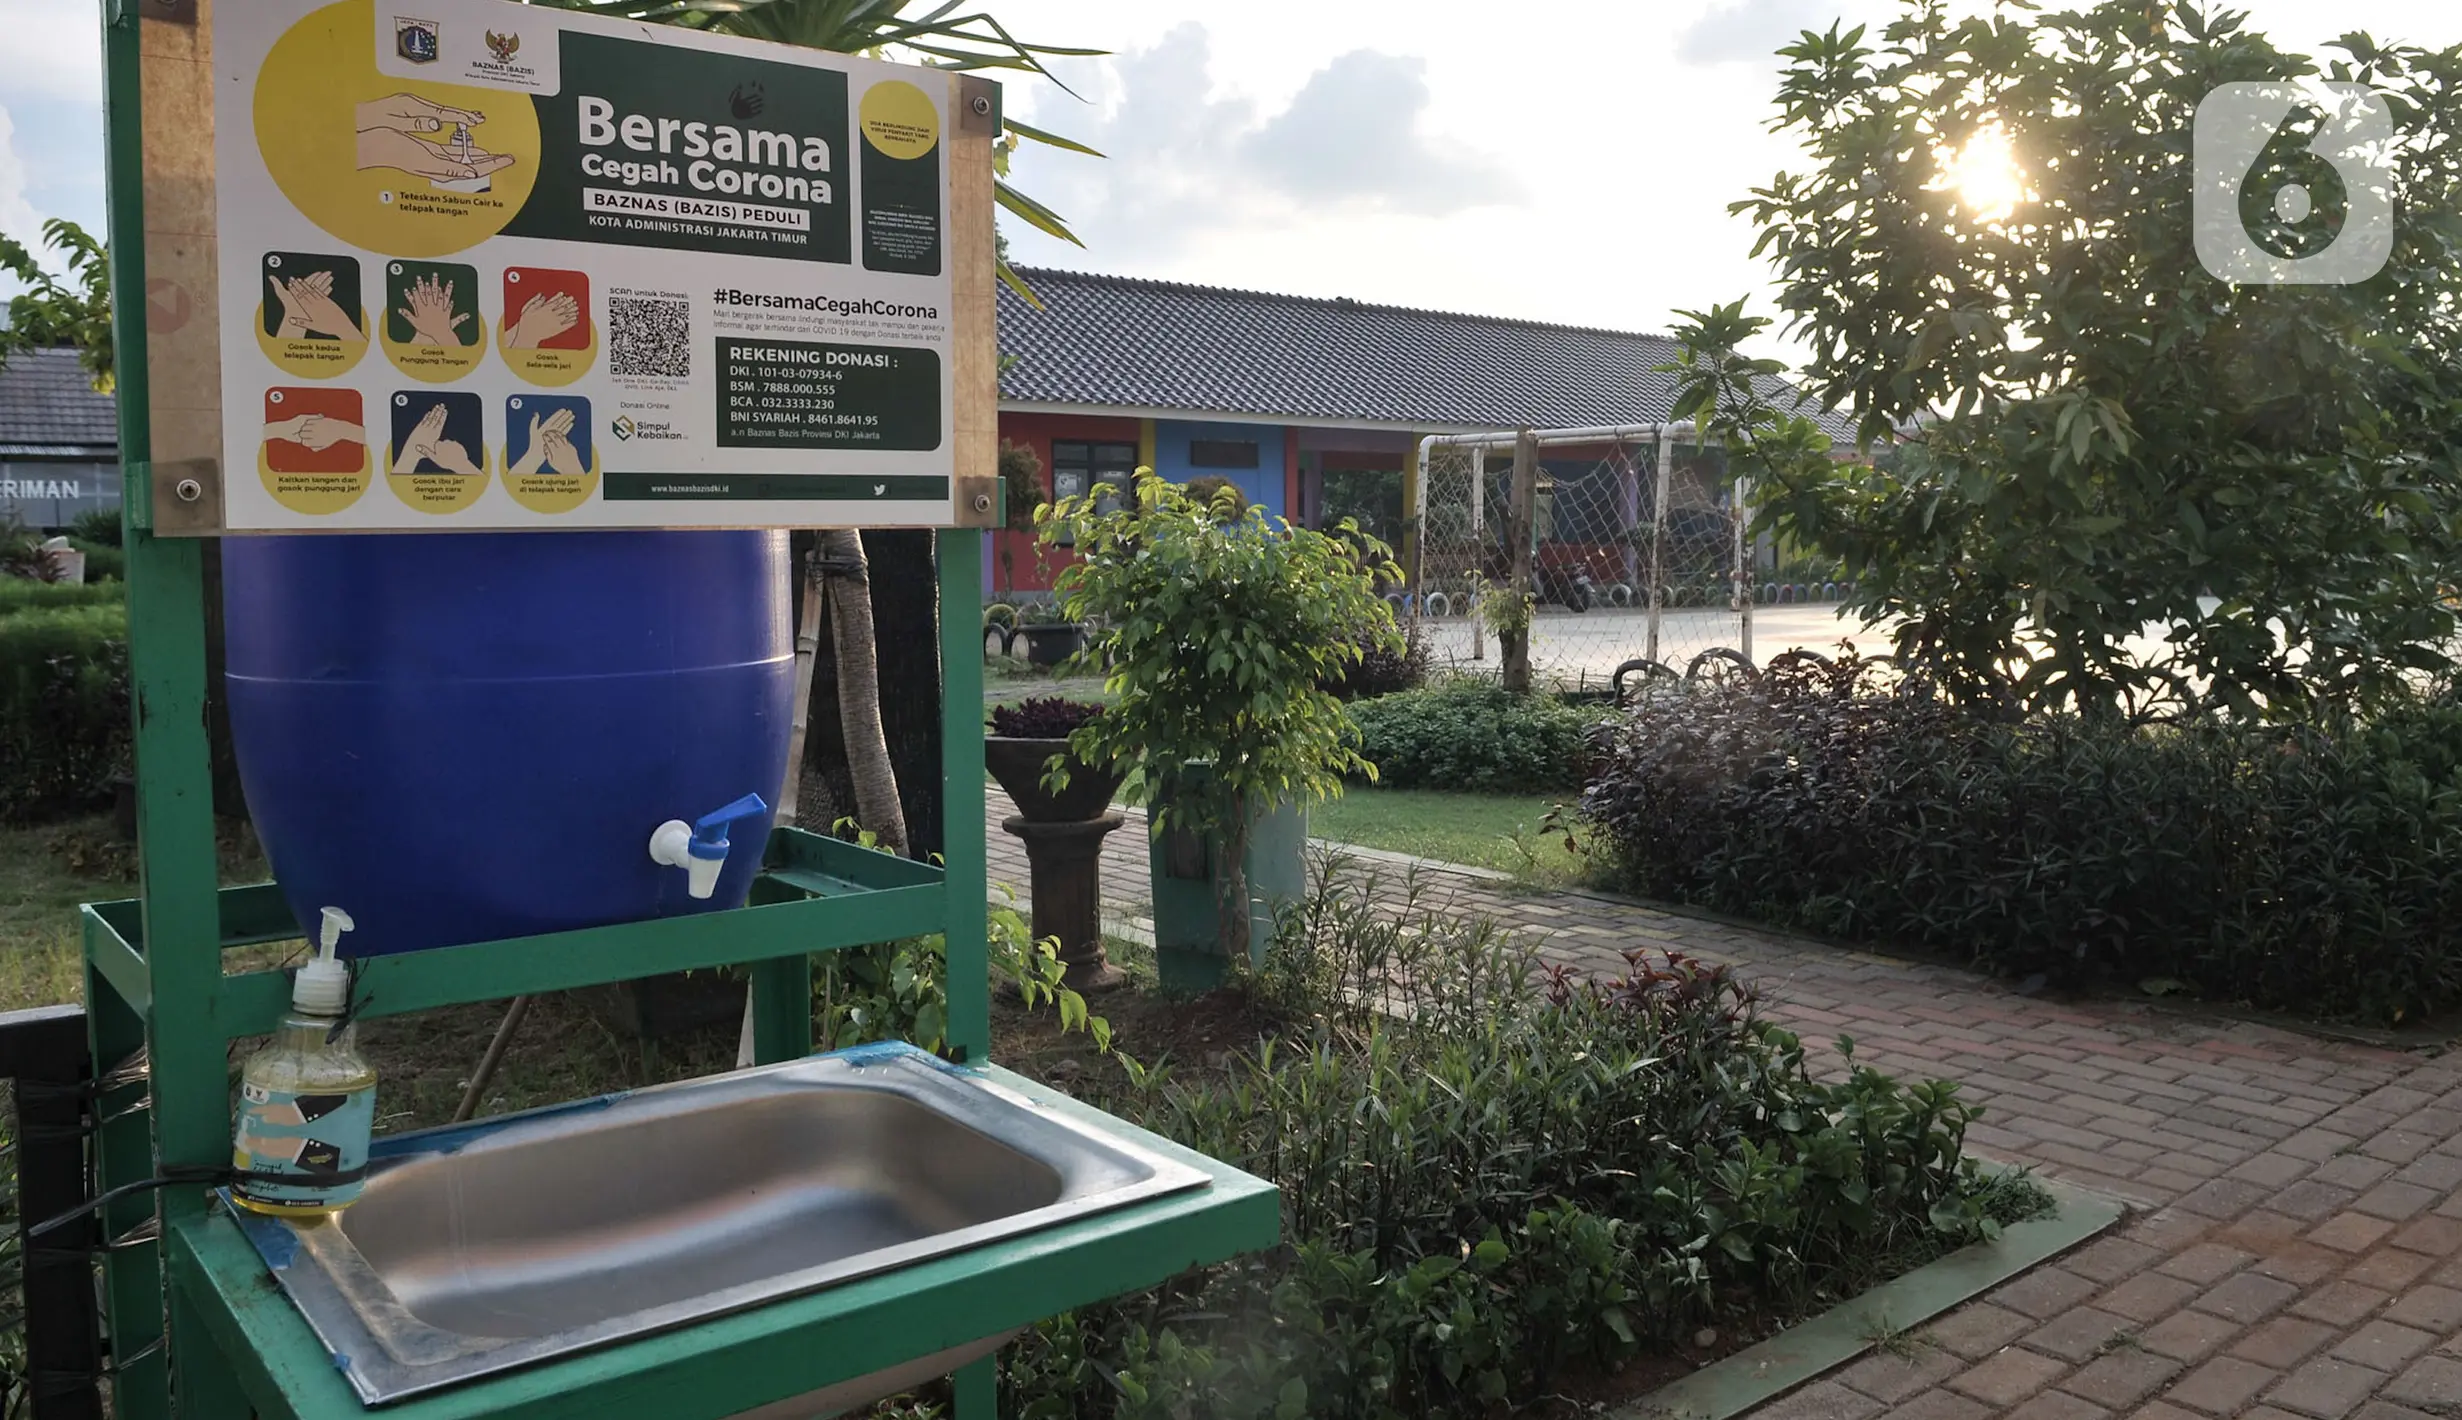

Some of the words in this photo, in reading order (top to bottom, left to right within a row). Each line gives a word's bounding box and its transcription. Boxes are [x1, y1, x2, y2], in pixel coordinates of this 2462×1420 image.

[472, 61, 504, 71] BAZNAS
[578, 95, 831, 172] Bersama
[581, 153, 679, 186] Cegah
[688, 160, 832, 204] Corona
[384, 193, 389, 201] 1
[400, 192, 441, 202] Teteskan
[442, 195, 472, 205] Sabun
[473, 198, 490, 207] Cair
[492, 200, 504, 208] ke
[400, 204, 434, 214] telapak
[436, 207, 468, 217] tangan
[594, 193, 668, 212] BAZNAS
[674, 200, 737, 220] (BAZIS)
[743, 209, 801, 225] PEDULI
[589, 215, 622, 228] KOTA
[625, 218, 714, 236] ADMINISTRASI
[716, 228, 768, 241] JAKARTA
[771, 232, 808, 245] TIMUR
[714, 288, 937, 319] #BersamaCegahCorona
[714, 309, 730, 317] Mari
[732, 311, 764, 320] bergerak
[766, 313, 796, 322] bersama
[798, 314, 825, 325] lindungi
[827, 318, 866, 327] masyarakat
[745, 323, 762, 332] agar
[797, 325, 810, 333] dari
[812, 325, 837, 335] COVID
[840, 327, 850, 336] 19
[850, 328, 876, 338] dengan
[878, 330, 900, 338] Donasi
[902, 332, 924, 340] terbaik
[926, 334, 941, 342] anda
[316, 344, 340, 352] kedua
[284, 352, 314, 361] telapak
[316, 353, 344, 361] tangan
[400, 356, 439, 365] Punggung
[441, 358, 469, 366] Tangan
[730, 346, 821, 364] REKENING
[826, 351, 888, 368] DONASI
[730, 366, 750, 377] DKI
[758, 366, 843, 381] 101-03-07934-6
[730, 381, 755, 392] BSM
[763, 382, 836, 396] 7888.000.555
[730, 396, 754, 407] BCA
[761, 398, 834, 410] 032.3333.230
[730, 412, 750, 422] BNI
[753, 412, 800, 424] SYARIAH
[808, 414, 878, 426] 8461.8641.95
[637, 422, 670, 431] Simpul
[637, 431, 682, 440] Kebaikan
[731, 429, 746, 437] a.n
[748, 428, 776, 438] Baznas
[778, 429, 800, 438] Bazis
[802, 429, 833, 438] Provinsi
[835, 430, 849, 439] DKI
[852, 430, 880, 440] Jakarta
[0, 480, 80, 499] RIMAN
[347, 485, 360, 493] jari
[414, 486, 443, 494] dengan
[651, 484, 729, 493] www.baznasbazisdki.id
